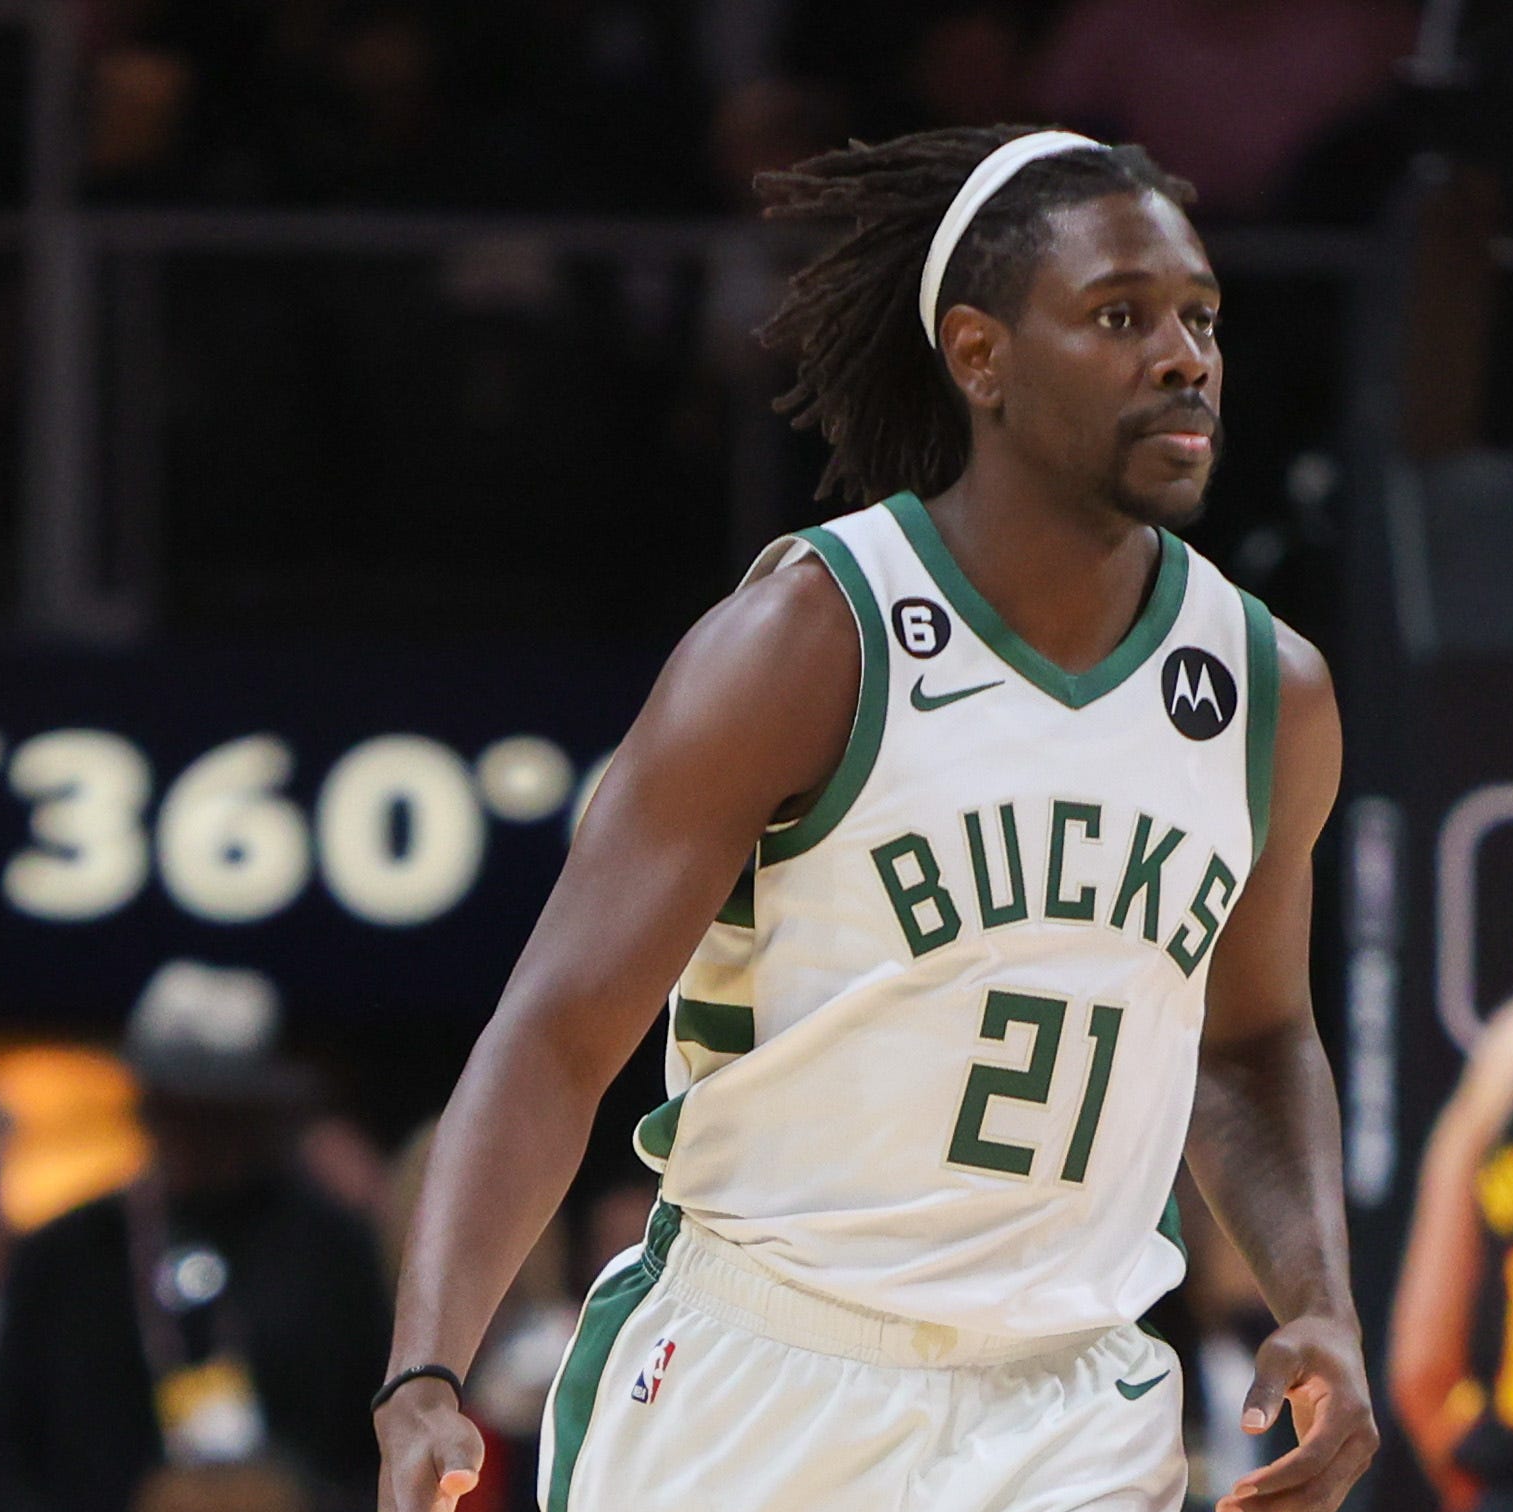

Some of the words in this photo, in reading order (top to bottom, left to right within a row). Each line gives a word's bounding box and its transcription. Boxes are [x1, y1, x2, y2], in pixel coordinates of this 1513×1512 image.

[900, 604, 937, 652] 6
[868, 797, 1238, 982] BUCKS
[944, 983, 1130, 1186] 21
